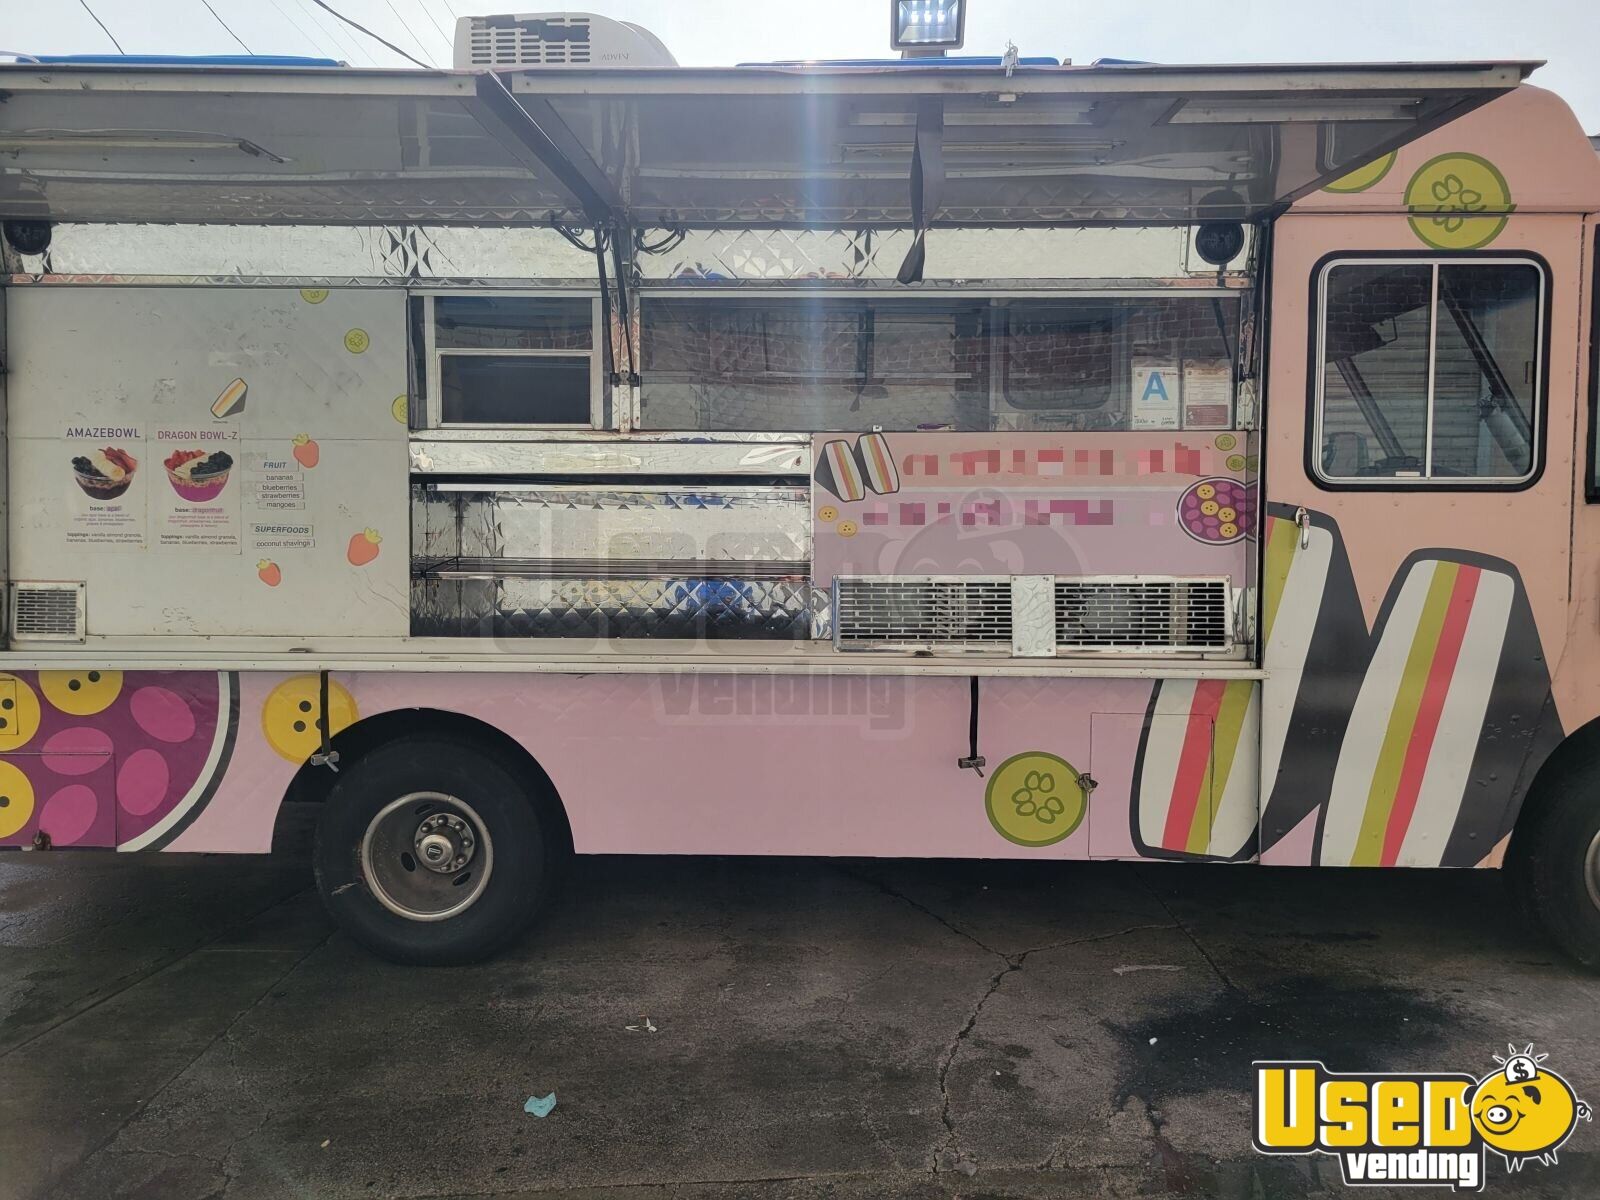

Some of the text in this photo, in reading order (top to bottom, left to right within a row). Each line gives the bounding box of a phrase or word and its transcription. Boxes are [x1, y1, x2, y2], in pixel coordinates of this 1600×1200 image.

[1141, 371, 1169, 401] A
[66, 427, 141, 438] AMAZEBOWL
[157, 430, 238, 440] DRAGON BOWL-Z
[263, 461, 287, 469] FRUIT
[255, 525, 310, 534] SUPERFOODS
